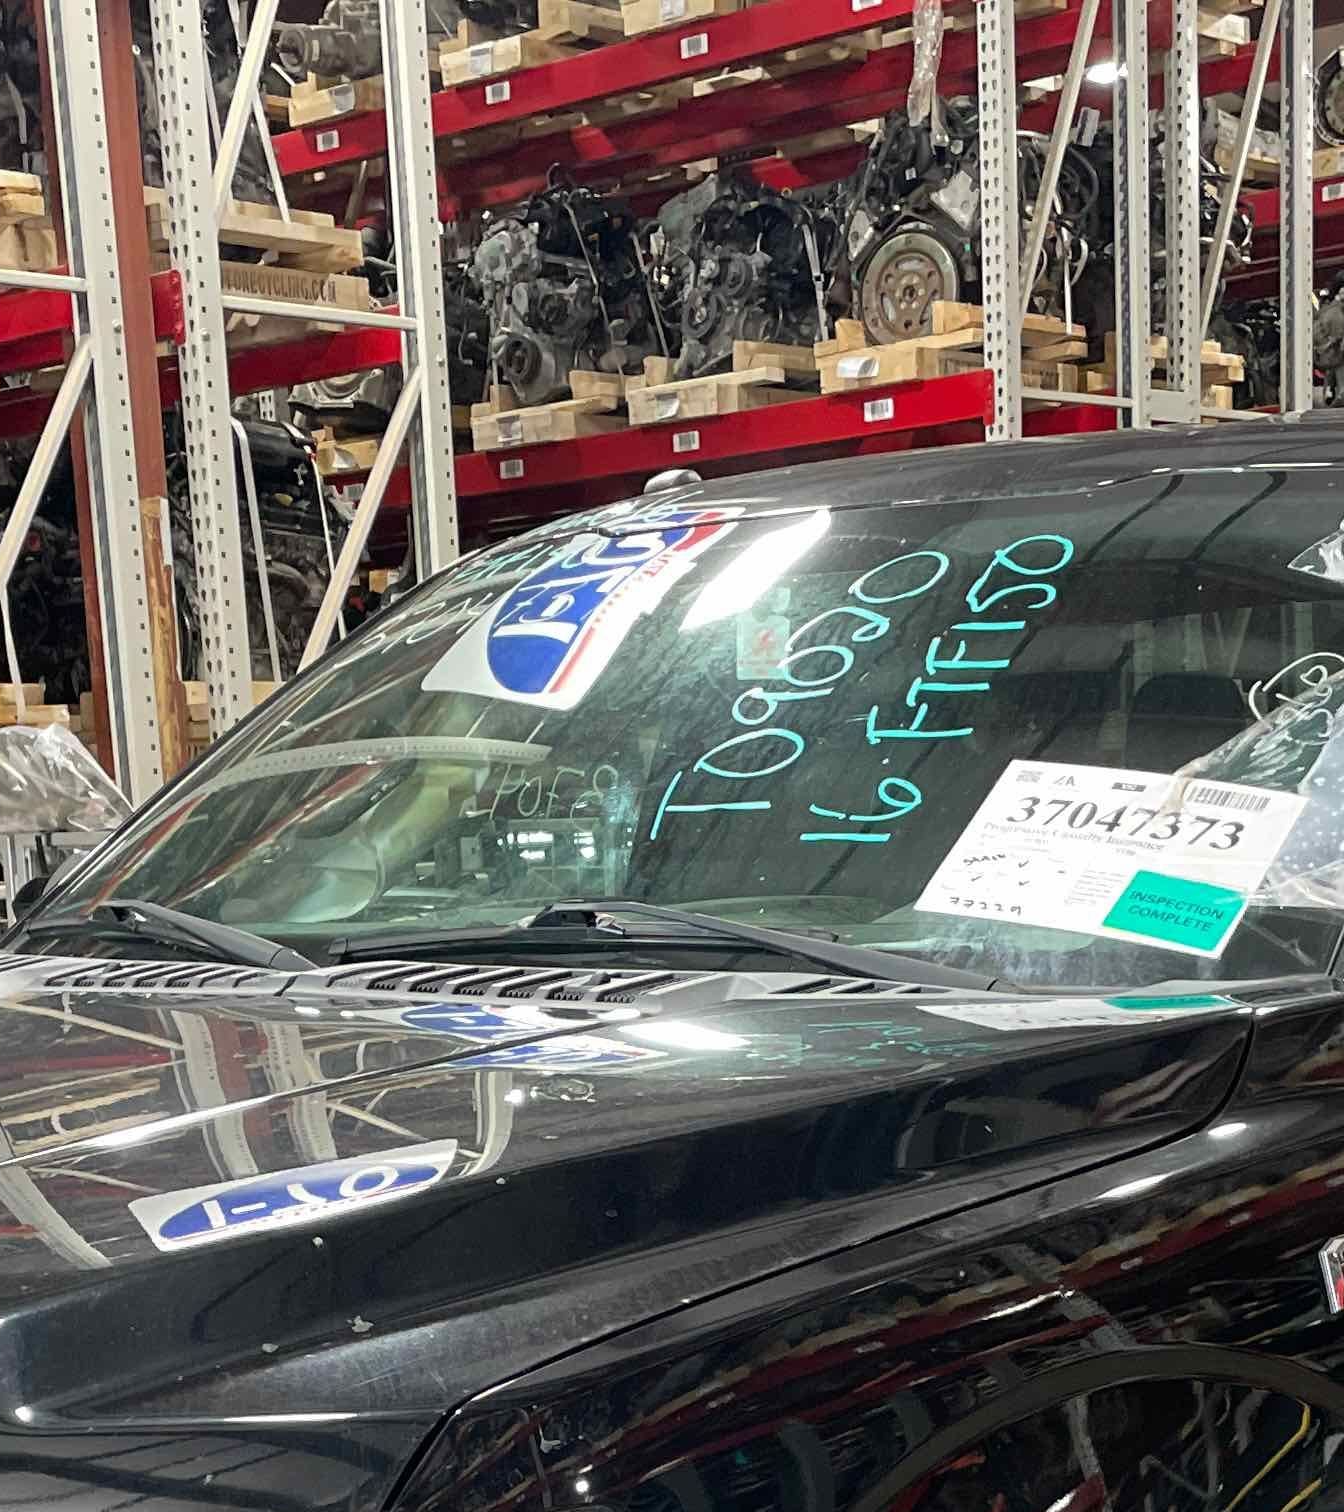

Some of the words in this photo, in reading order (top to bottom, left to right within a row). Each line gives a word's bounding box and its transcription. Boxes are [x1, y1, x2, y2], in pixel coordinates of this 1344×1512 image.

[1006, 796, 1246, 851] 37047373
[1126, 903, 1214, 934] COMPLETE
[1129, 889, 1225, 921] INSPECTION
